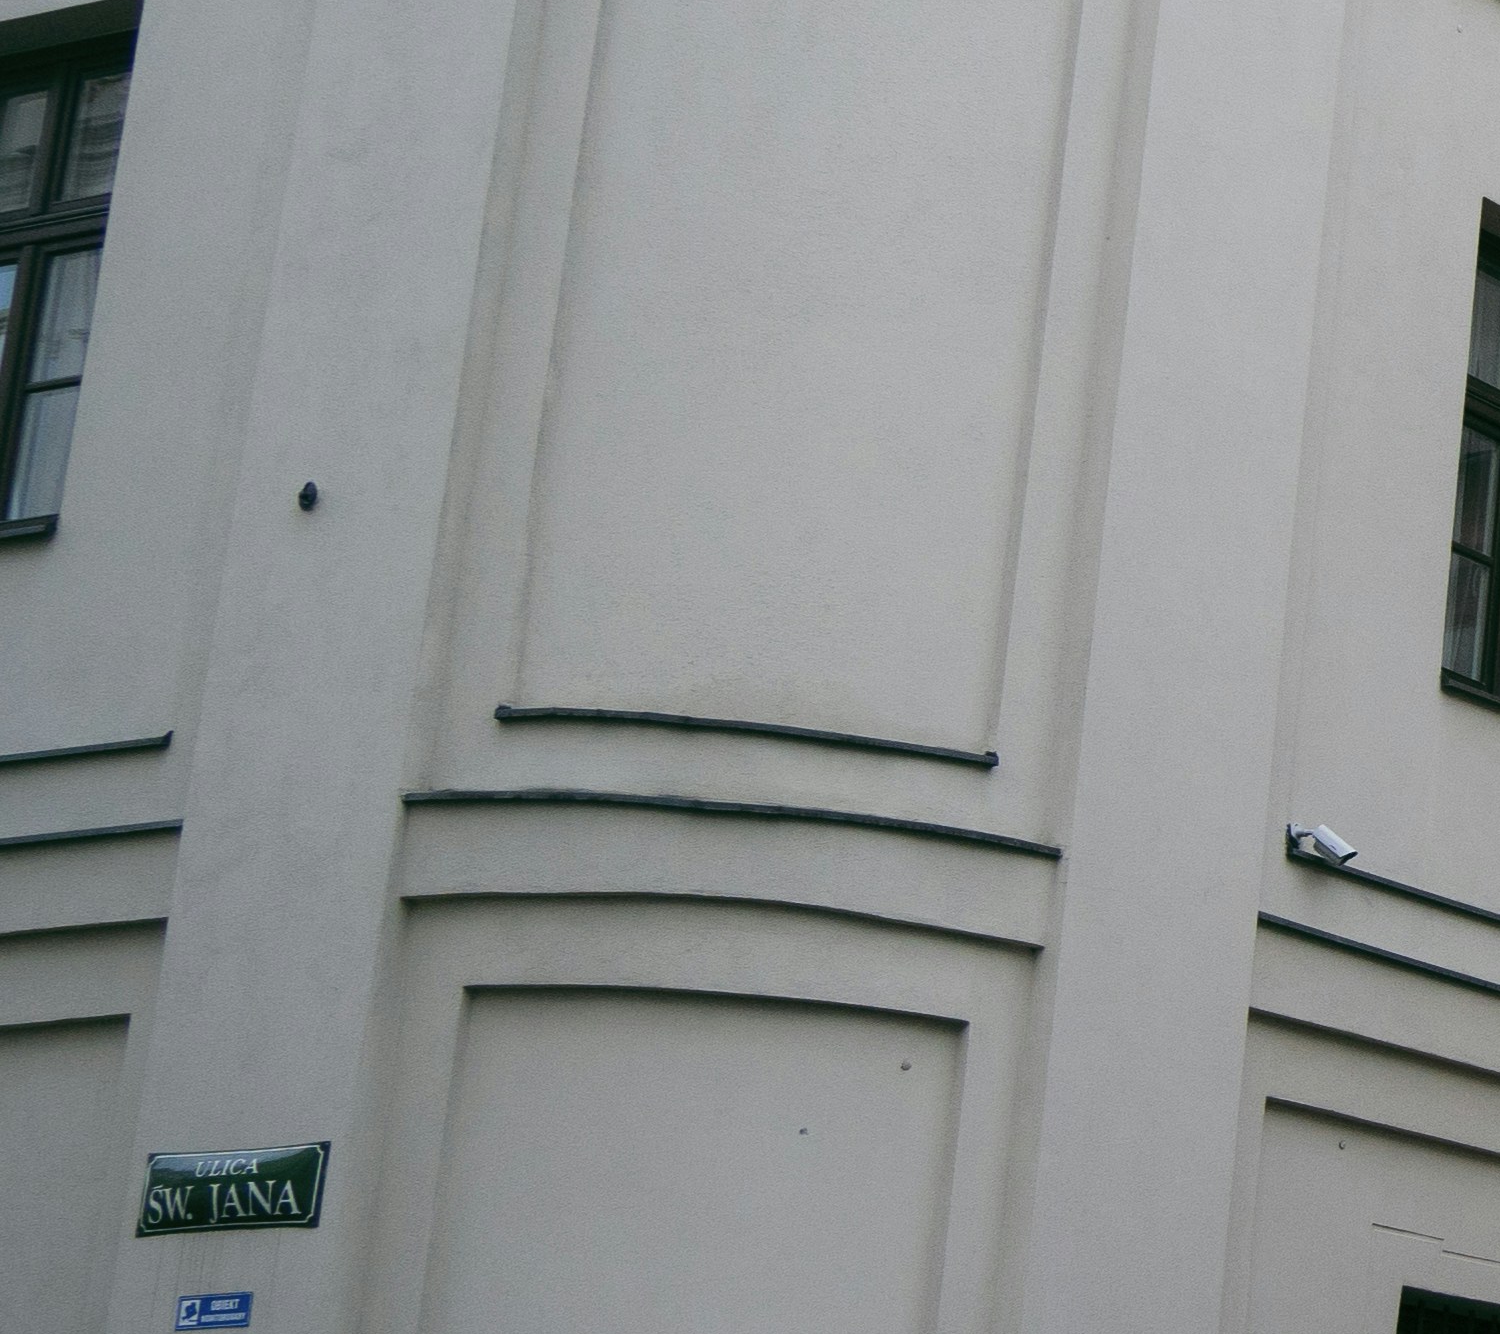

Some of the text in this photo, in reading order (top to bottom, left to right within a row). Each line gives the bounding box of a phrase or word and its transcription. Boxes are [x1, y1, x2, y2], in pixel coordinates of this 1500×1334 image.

[195, 1157, 259, 1178] ULICA
[147, 1180, 303, 1224] ŚW. JANA
